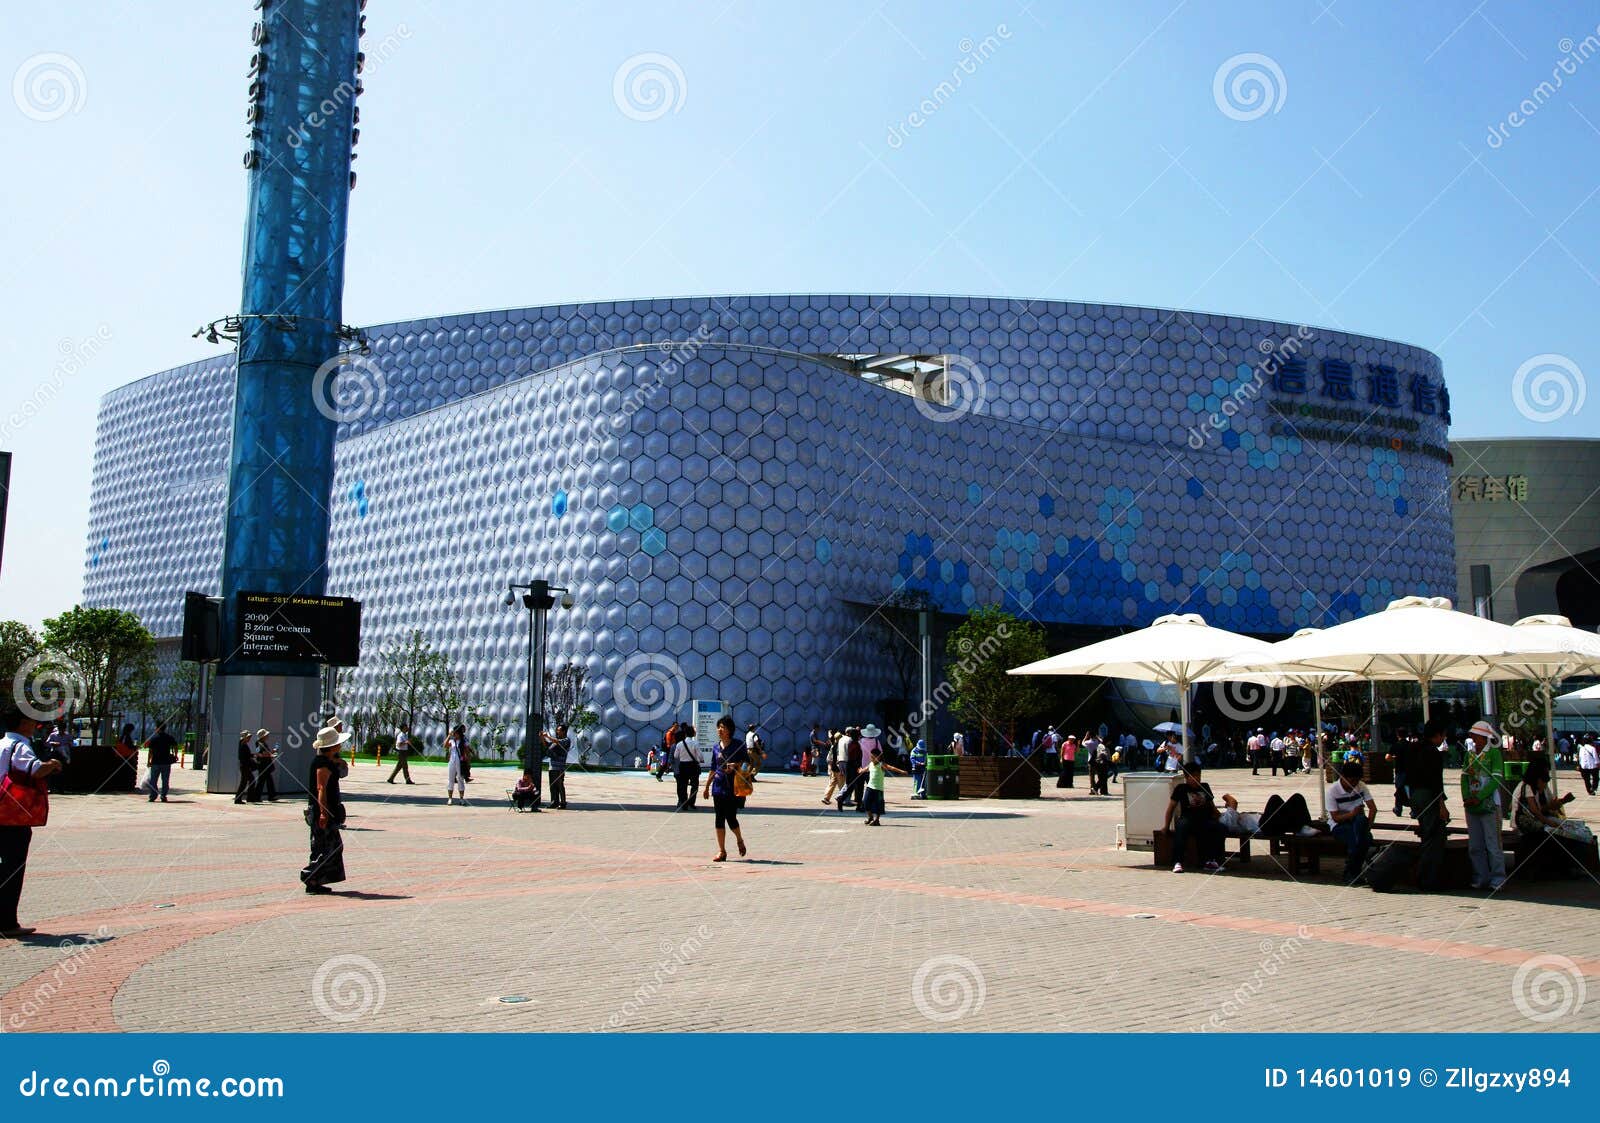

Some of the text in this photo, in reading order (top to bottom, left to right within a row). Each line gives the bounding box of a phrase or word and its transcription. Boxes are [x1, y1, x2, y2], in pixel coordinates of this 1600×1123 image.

[1457, 475, 1529, 502] 汽车馆
[244, 613, 269, 622] 20:00
[244, 623, 252, 631] B
[276, 624, 311, 633] Oceania
[243, 632, 275, 643] Square
[243, 642, 289, 651] Interactive
